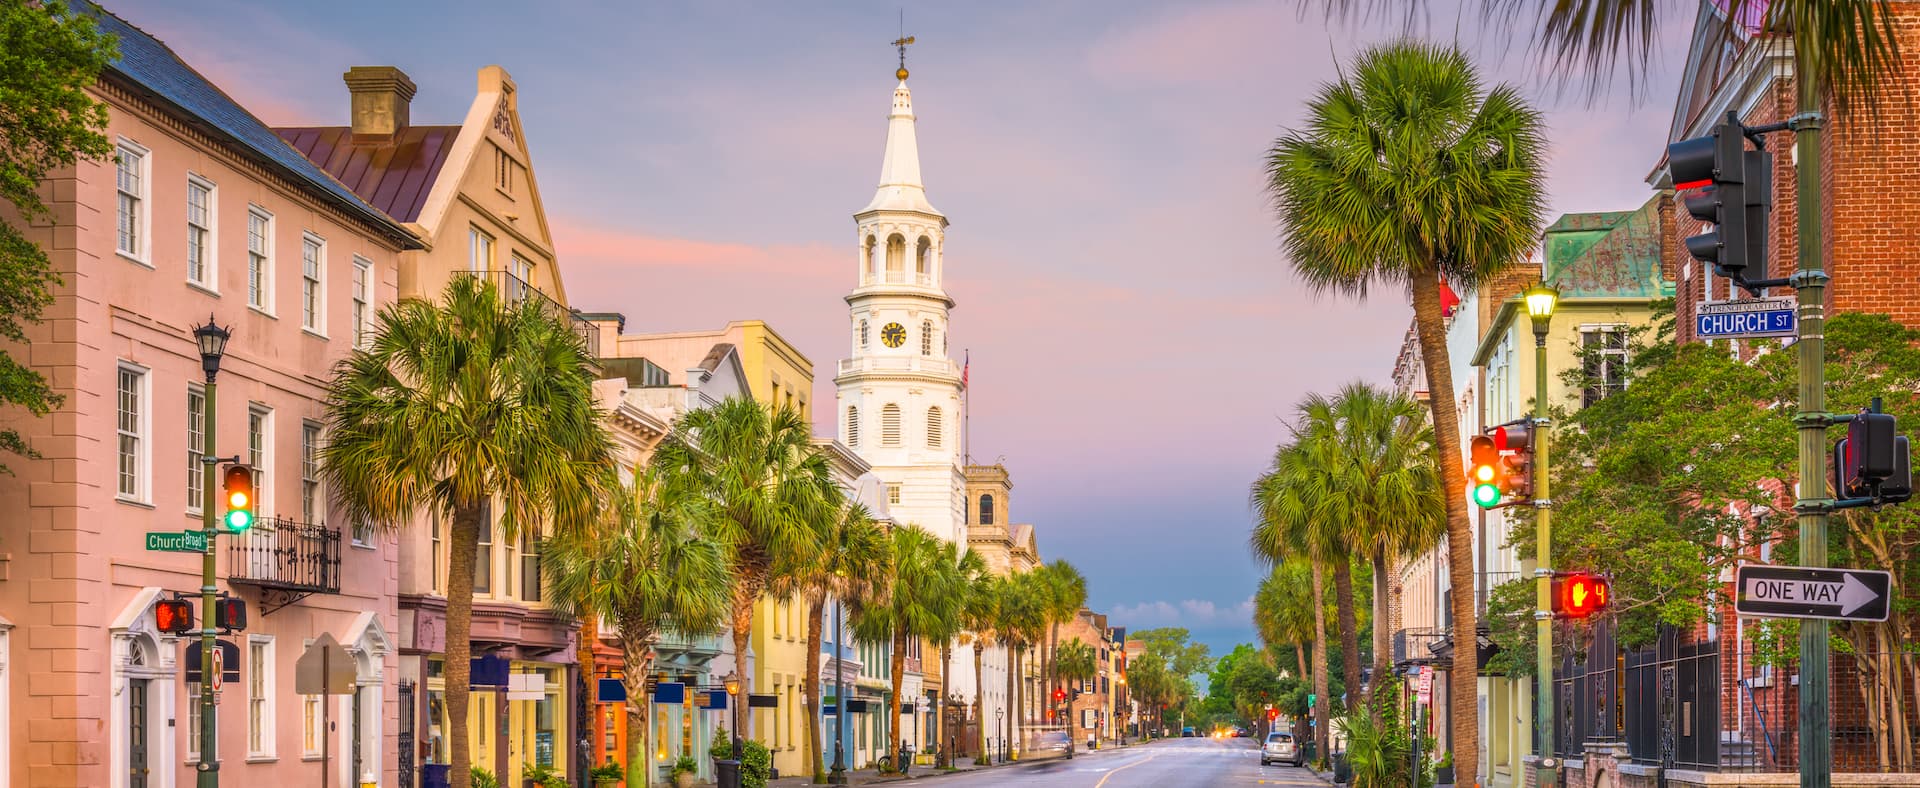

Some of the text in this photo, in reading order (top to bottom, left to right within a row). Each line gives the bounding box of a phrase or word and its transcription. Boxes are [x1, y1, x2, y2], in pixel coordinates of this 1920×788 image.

[1701, 313, 1789, 334] CHURCH ST
[185, 531, 202, 547] Broad
[1595, 584, 1605, 604] 4
[1755, 581, 1844, 602] ONE WAY
